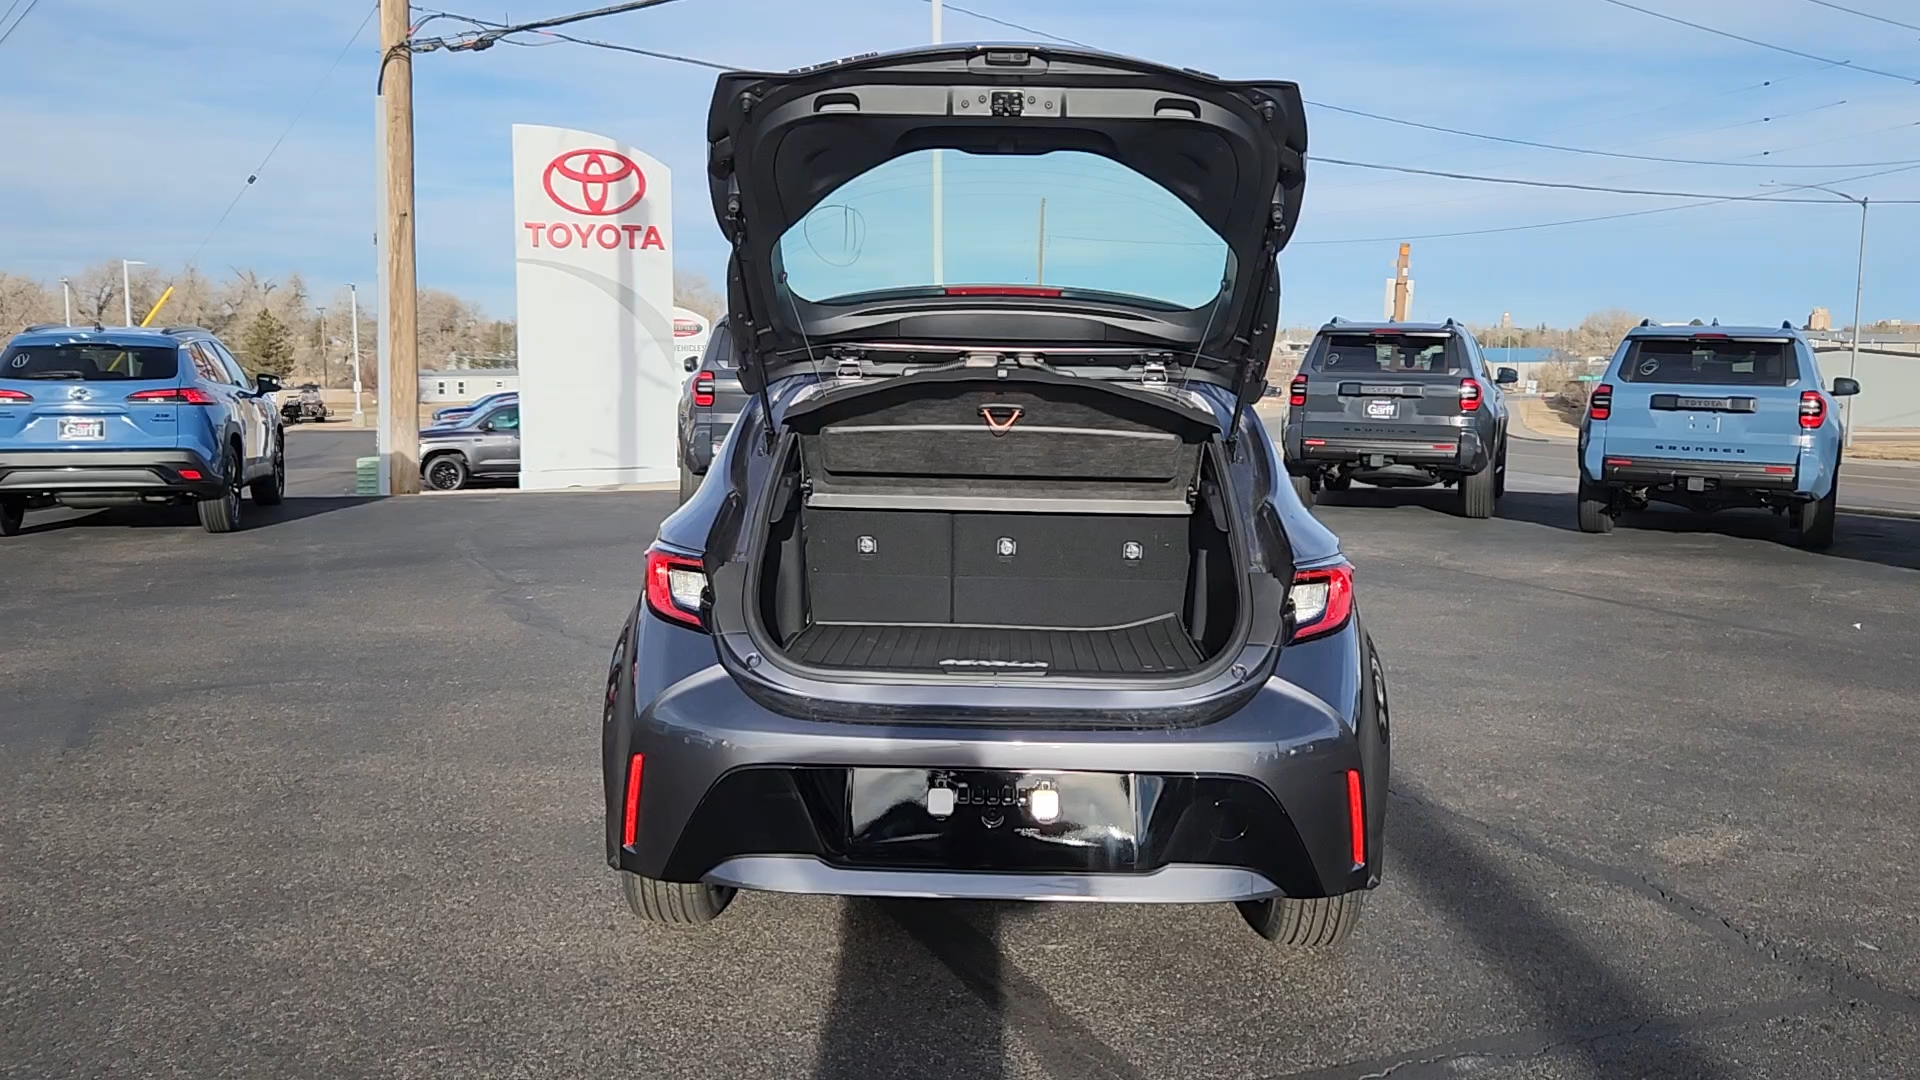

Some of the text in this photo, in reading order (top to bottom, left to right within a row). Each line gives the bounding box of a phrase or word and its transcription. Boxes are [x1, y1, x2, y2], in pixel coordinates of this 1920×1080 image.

[523, 222, 666, 251] TOYOTA
[1367, 404, 1395, 416] Garff
[1684, 399, 1723, 408] TOYOTA
[63, 422, 101, 436] Garff
